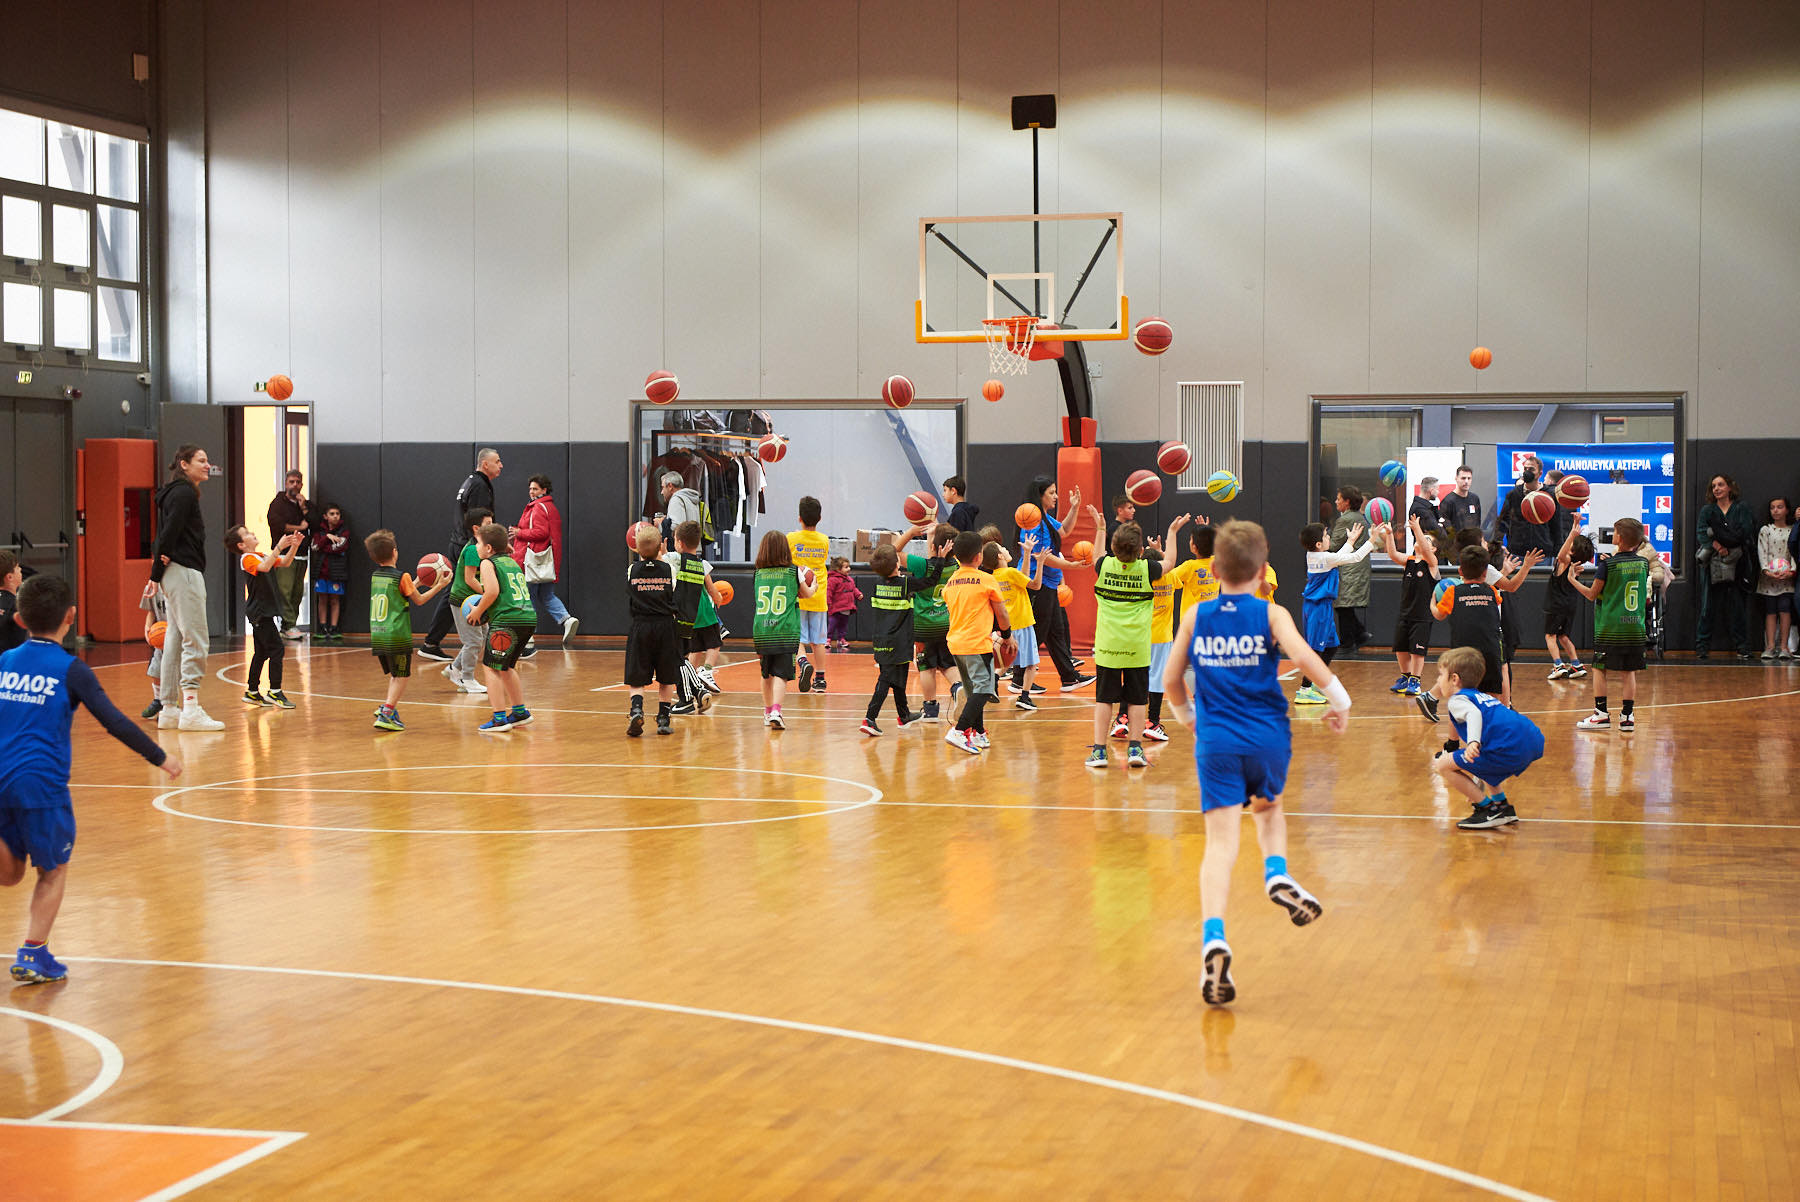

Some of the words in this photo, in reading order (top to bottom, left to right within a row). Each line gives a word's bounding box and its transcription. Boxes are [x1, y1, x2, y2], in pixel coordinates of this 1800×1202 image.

[1555, 459, 1614, 471] ΓΑΛΑΝΟΛΕΥΚΑ
[1616, 459, 1651, 471] ΑΣΤΕΡΙΑ
[506, 572, 531, 601] 58
[1104, 579, 1143, 588] BASKETBALL
[370, 593, 389, 622] 10
[756, 585, 787, 616] 56
[1624, 580, 1640, 612] 6
[1193, 634, 1267, 656] ΑΙΟΛΟΣ
[1198, 655, 1260, 668] basketball
[0, 671, 60, 697] ΙΟΛΟΣ
[0, 690, 47, 705] sketball
